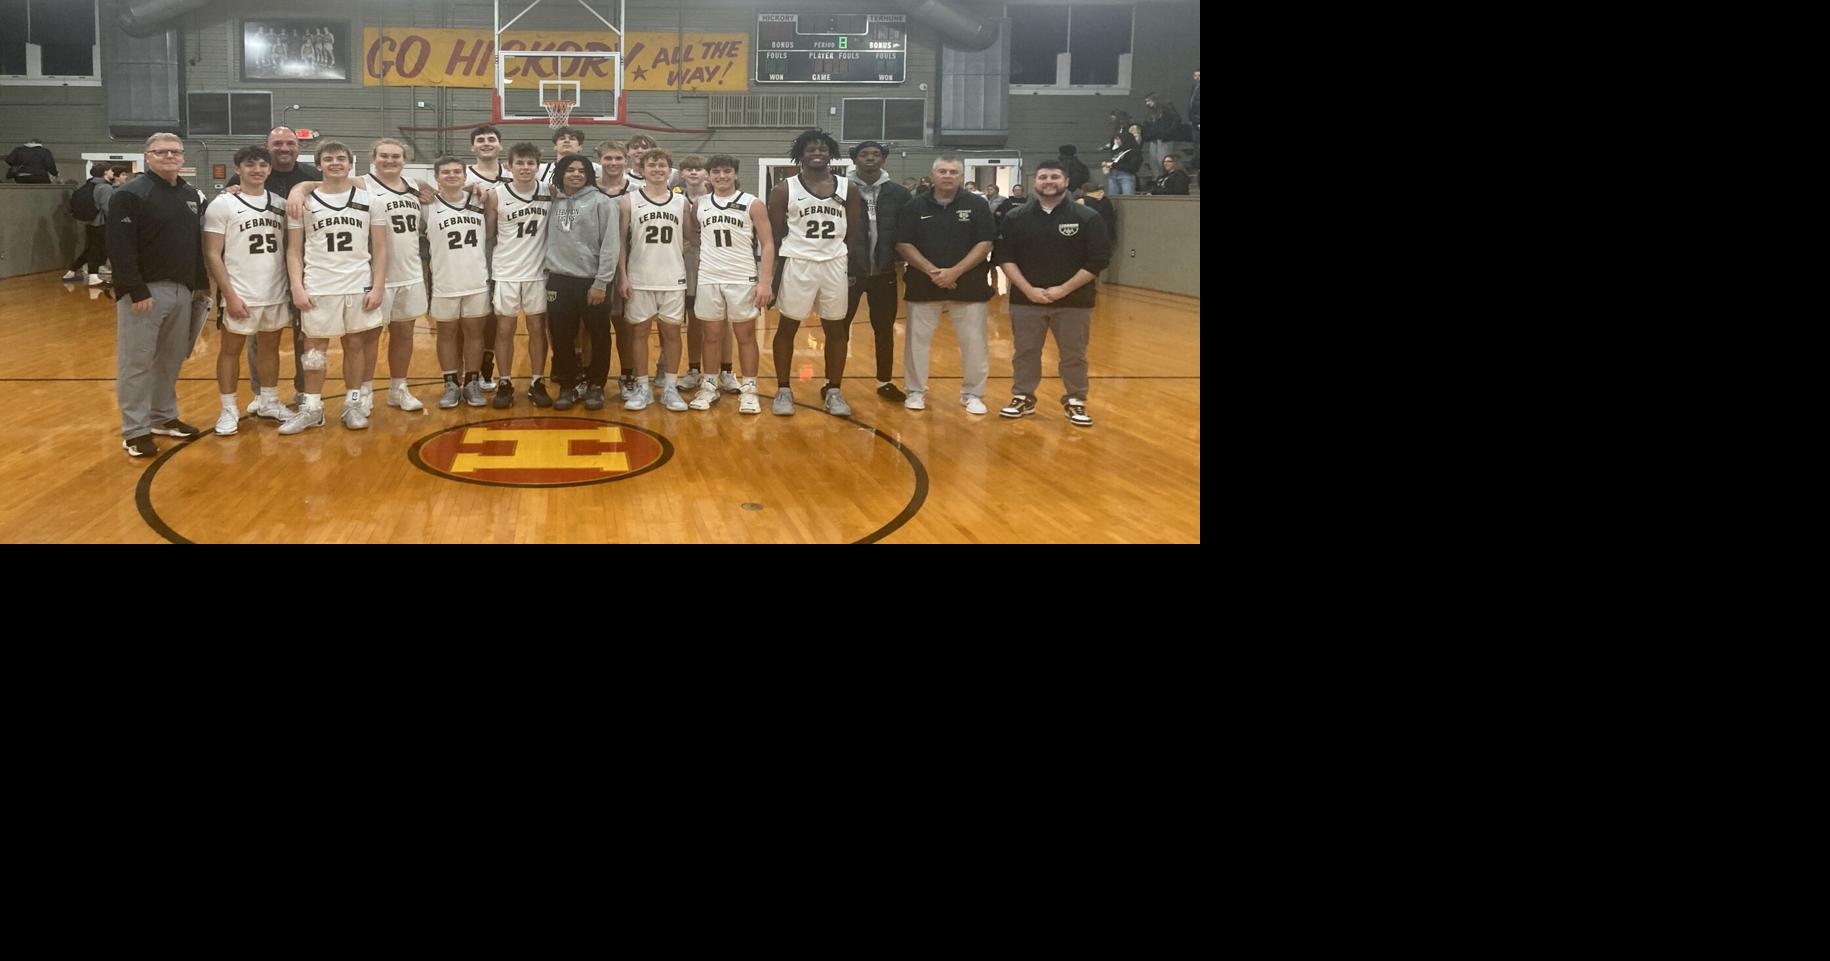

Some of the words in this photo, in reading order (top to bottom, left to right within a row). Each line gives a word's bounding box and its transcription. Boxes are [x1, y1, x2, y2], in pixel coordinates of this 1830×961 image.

[771, 41, 794, 49] BONUS
[869, 41, 892, 49] BONUS
[366, 35, 431, 79] GO
[445, 38, 646, 82] HICKORY
[651, 44, 695, 69] ALL
[701, 40, 743, 60] THE
[809, 52, 834, 60] PLAYER
[838, 52, 860, 60] FOULS
[875, 52, 897, 60] FOULS
[667, 61, 734, 86] WAY!
[507, 206, 548, 221] LEBANON
[639, 211, 679, 225] LEBANON
[800, 205, 843, 218] LEBANON
[313, 216, 363, 232] LEBANON
[391, 214, 417, 233] 50
[438, 215, 482, 230] LEBANON
[517, 219, 539, 238] 14
[702, 215, 744, 228] LEBANON
[806, 220, 836, 239] 22
[249, 233, 278, 254] 25
[326, 231, 353, 252] 12
[447, 229, 478, 250] 24
[645, 225, 673, 244] 20
[713, 229, 732, 247] 11
